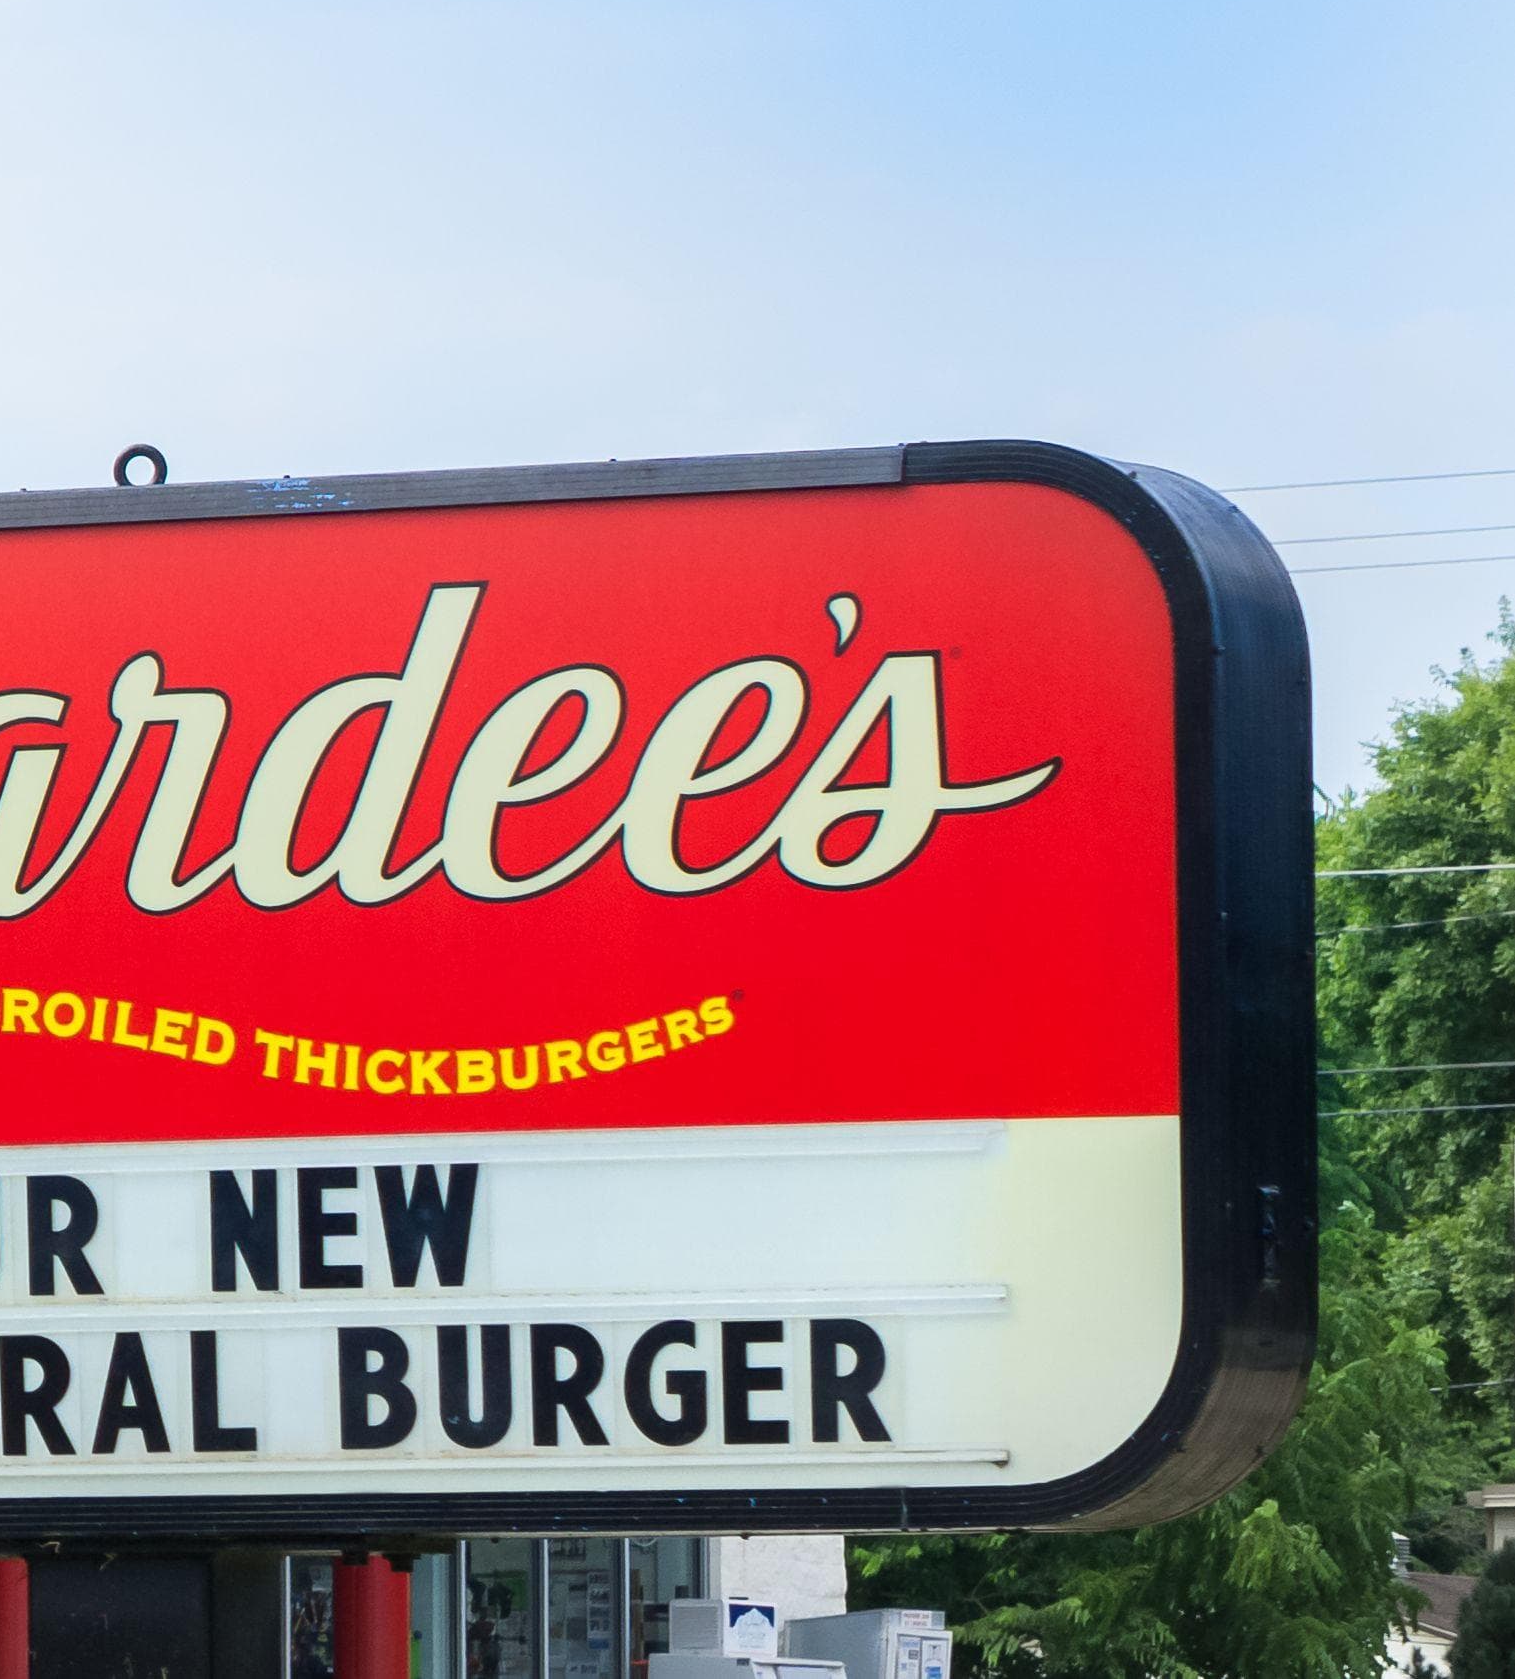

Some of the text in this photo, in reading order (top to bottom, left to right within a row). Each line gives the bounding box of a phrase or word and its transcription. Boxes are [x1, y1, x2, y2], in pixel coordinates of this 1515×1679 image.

[255, 996, 736, 1096] THICKBURGERS
[210, 1163, 479, 1290] NEW
[340, 1320, 893, 1452] BURGER
